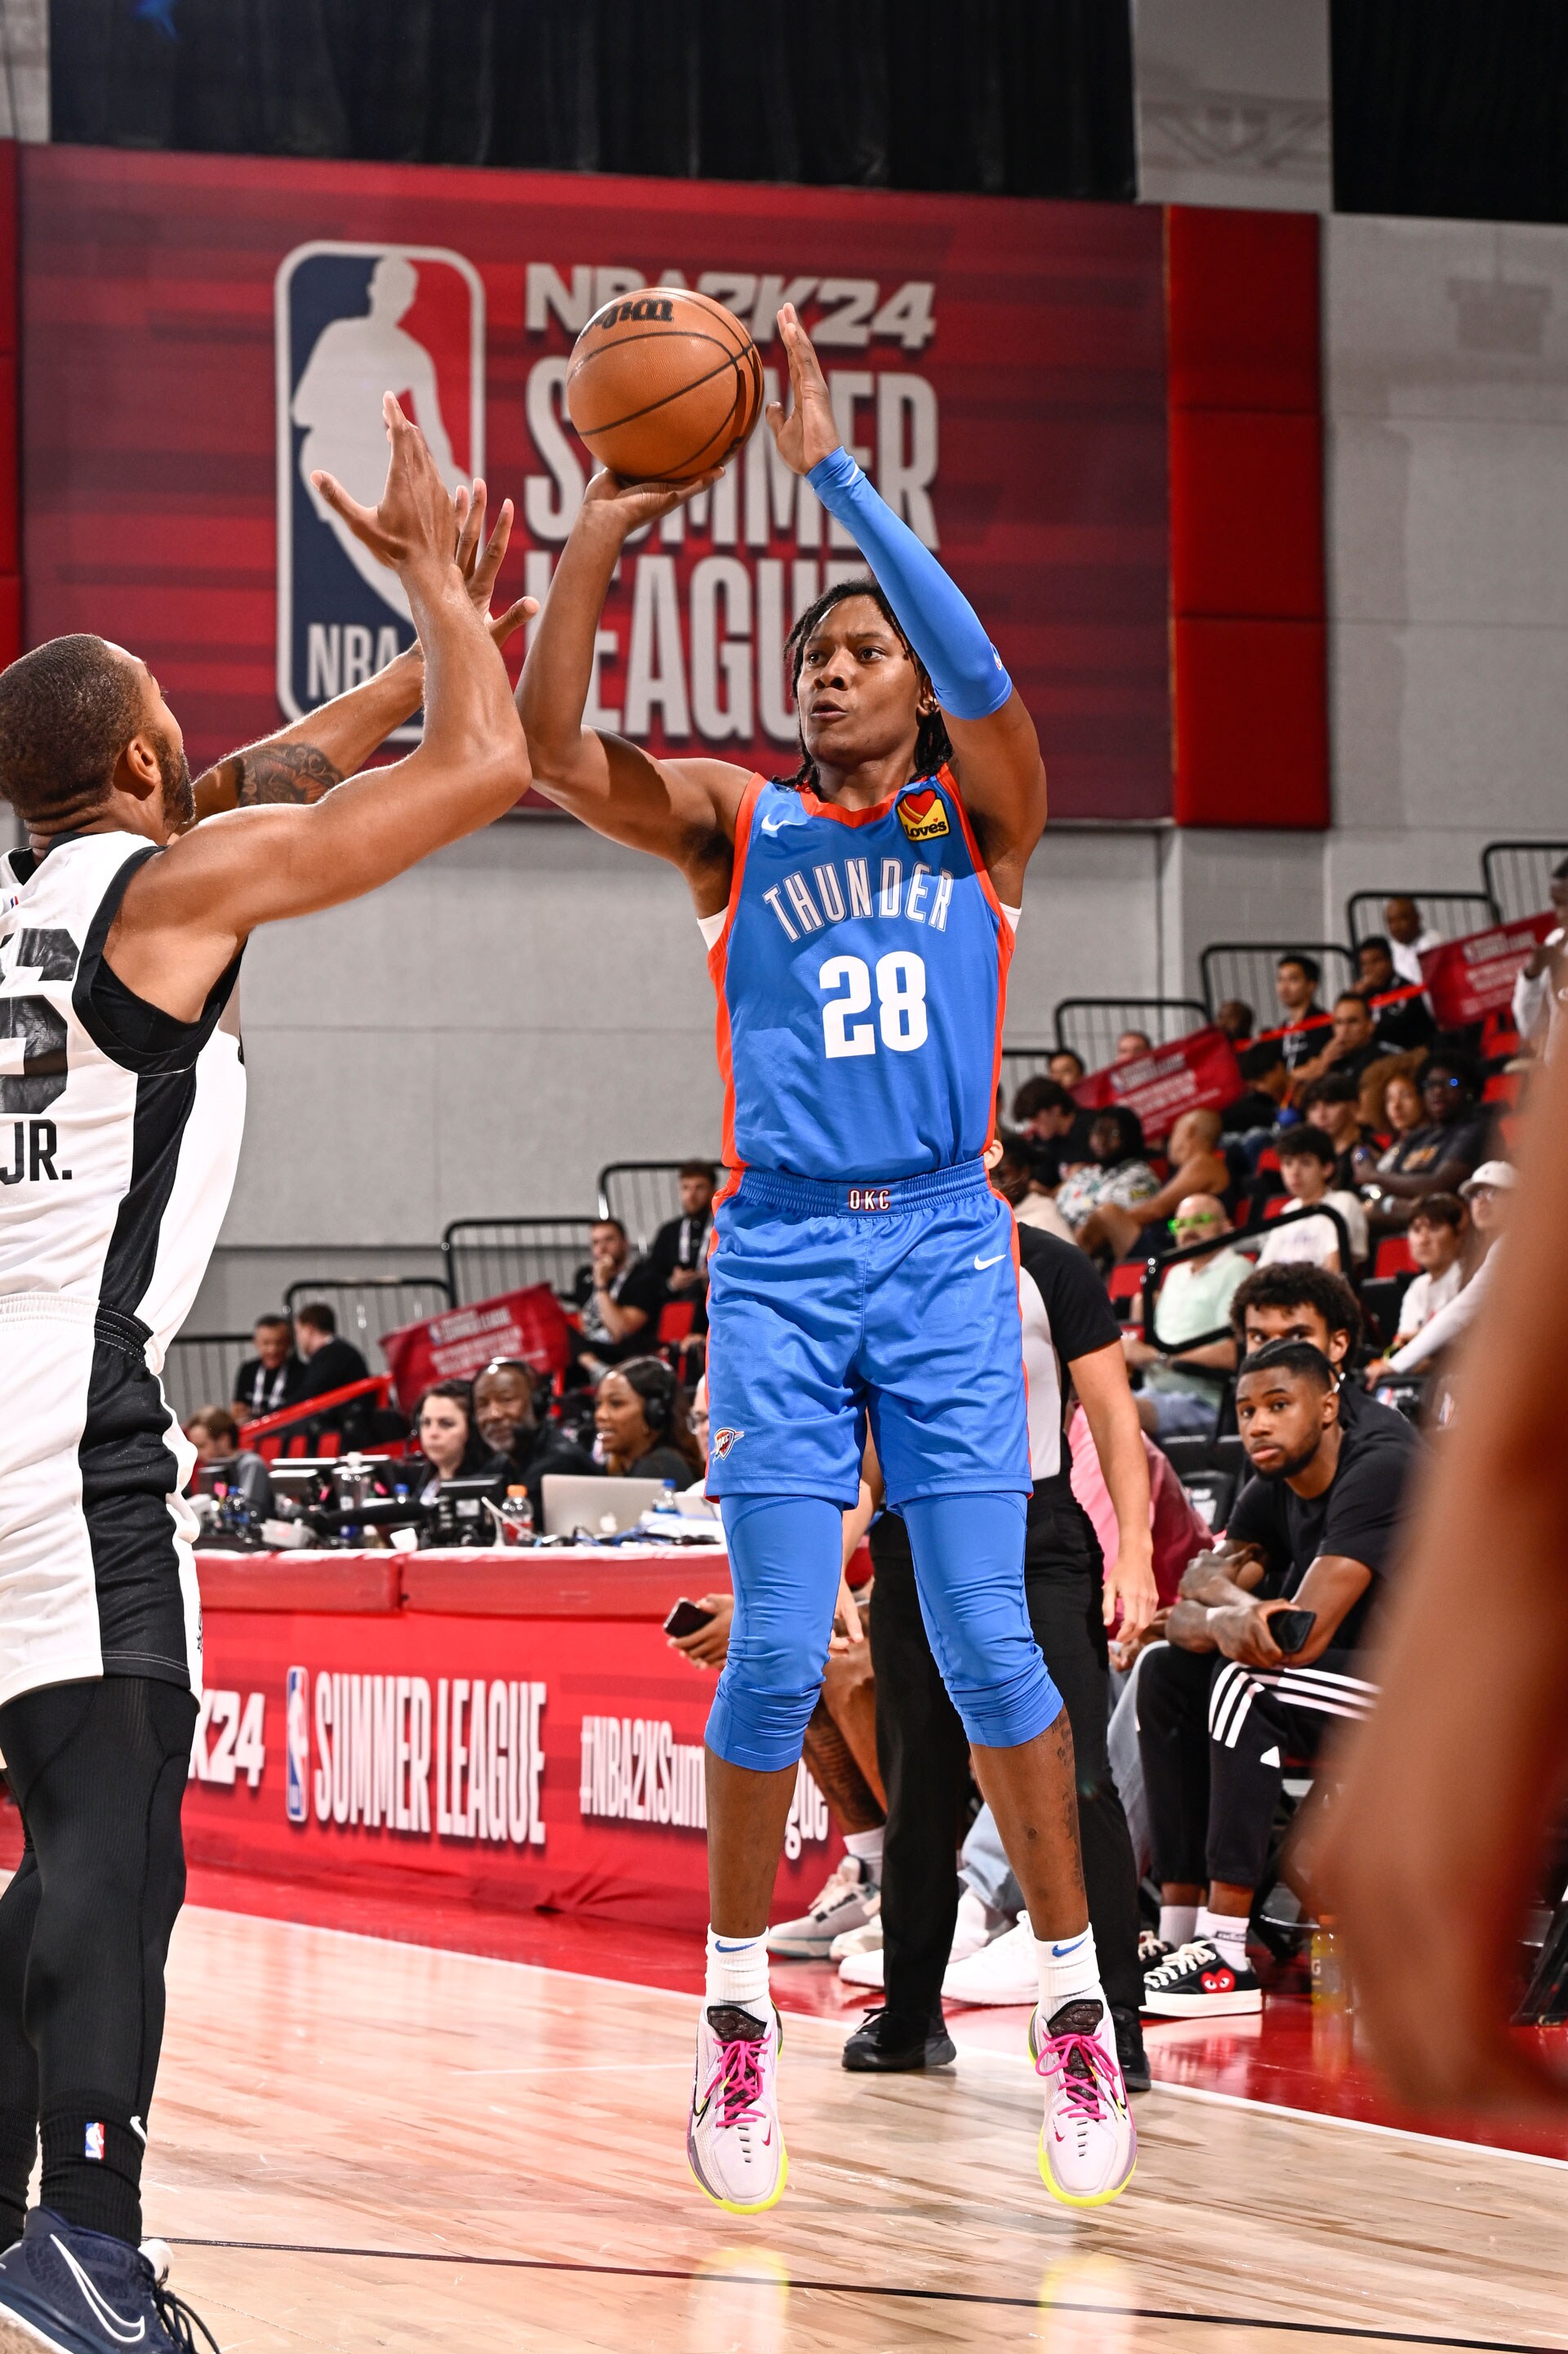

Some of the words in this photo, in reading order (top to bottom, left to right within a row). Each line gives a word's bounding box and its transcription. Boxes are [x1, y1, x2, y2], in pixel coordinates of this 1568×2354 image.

[523, 355, 939, 550] SMER
[762, 858, 954, 943] THUNDER
[819, 951, 929, 1059] 28
[0, 1119, 73, 1185] JR.
[848, 1188, 891, 1211] OKC
[314, 1670, 432, 1833] SUMMER
[436, 1678, 547, 1845] LEAGUE
